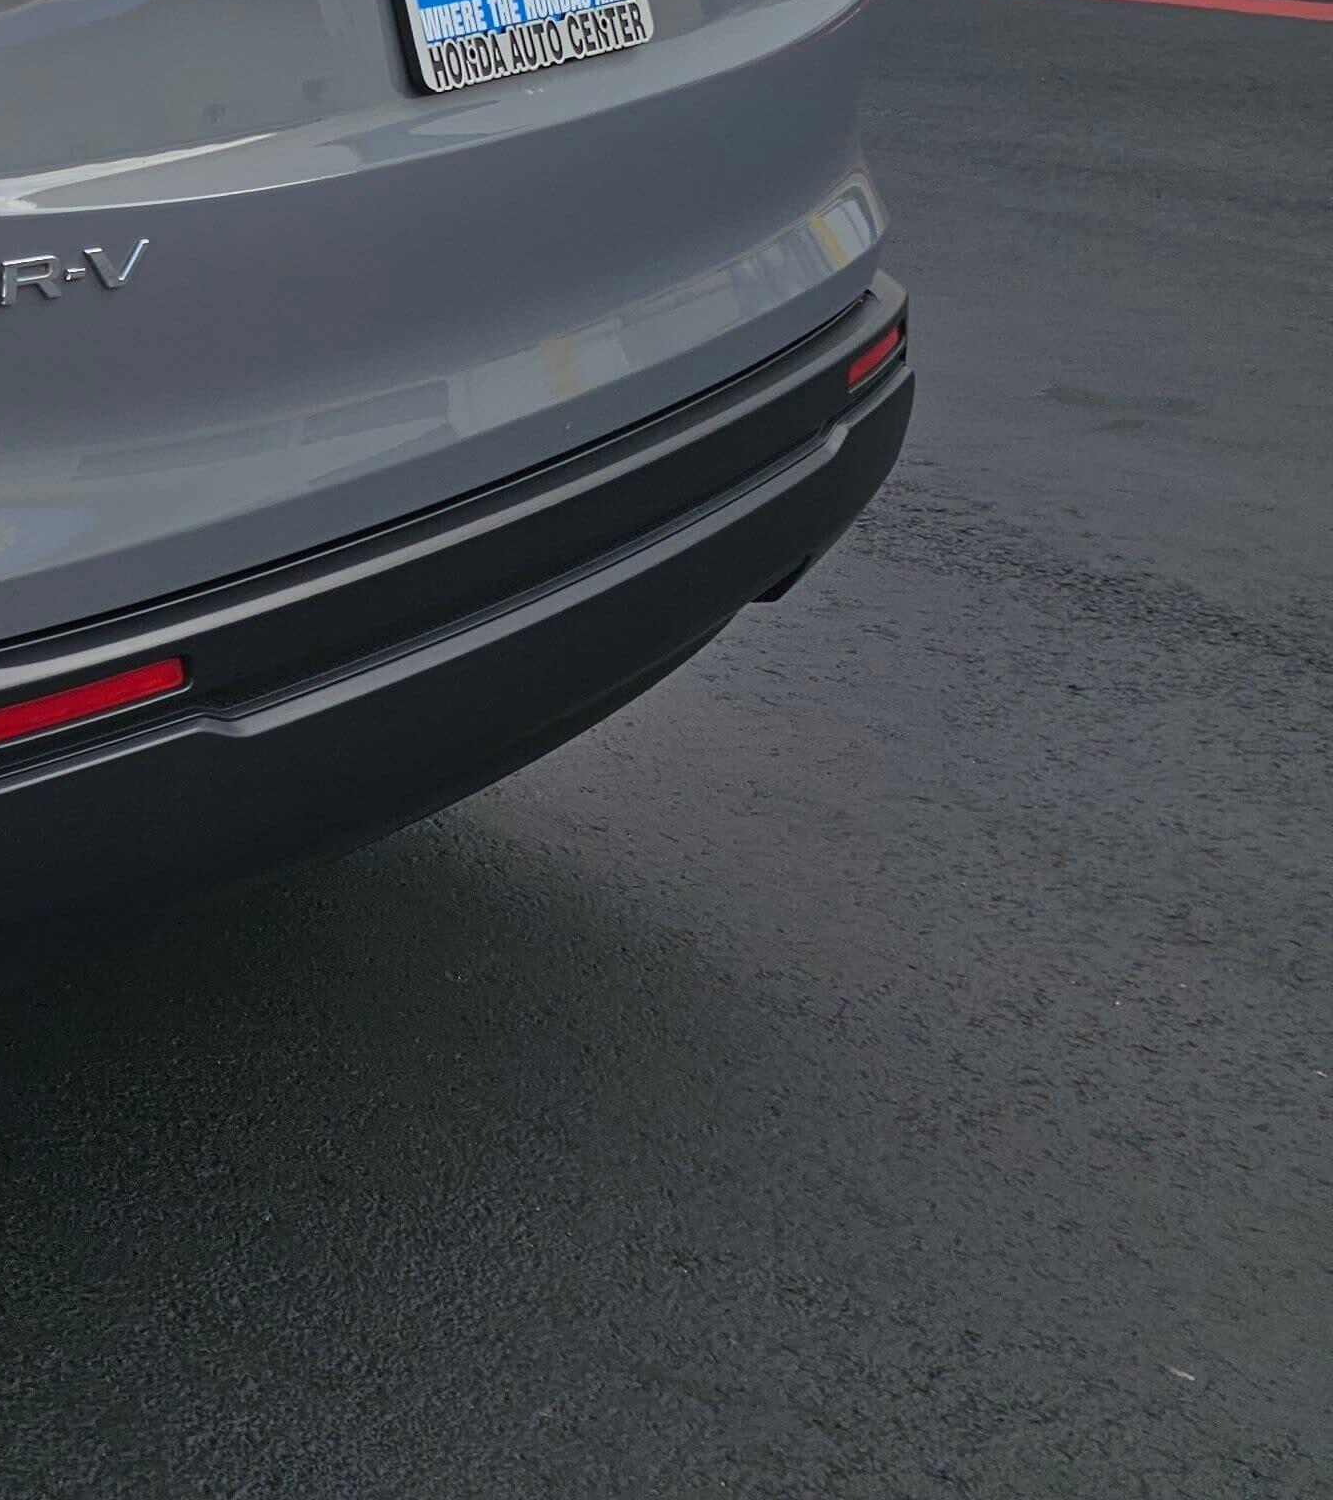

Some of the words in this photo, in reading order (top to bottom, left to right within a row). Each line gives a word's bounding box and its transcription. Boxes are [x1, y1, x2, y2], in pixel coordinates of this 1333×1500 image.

[427, 32, 508, 89] HONDA
[508, 18, 564, 73] AUTO
[566, 3, 648, 57] CENTER
